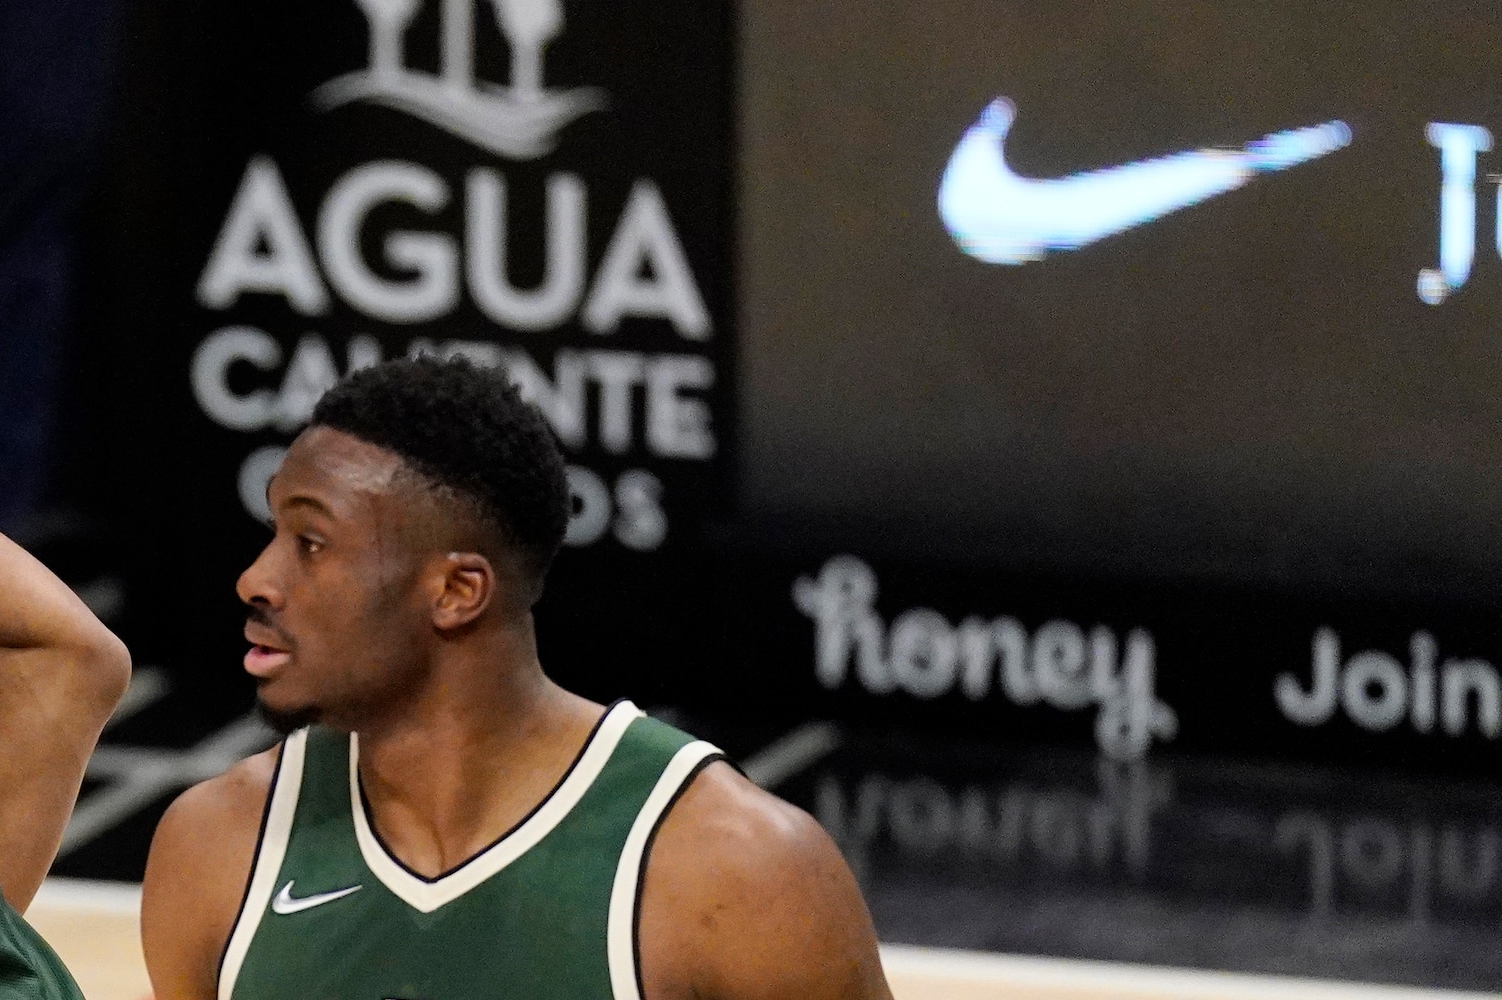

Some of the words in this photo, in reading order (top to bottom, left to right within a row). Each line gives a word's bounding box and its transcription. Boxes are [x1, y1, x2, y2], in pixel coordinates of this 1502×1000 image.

[198, 154, 714, 340] AGUA
[1417, 121, 1502, 305] J
[189, 326, 716, 459] CANTE
[793, 554, 1179, 760] honey
[1273, 624, 1502, 740] Join
